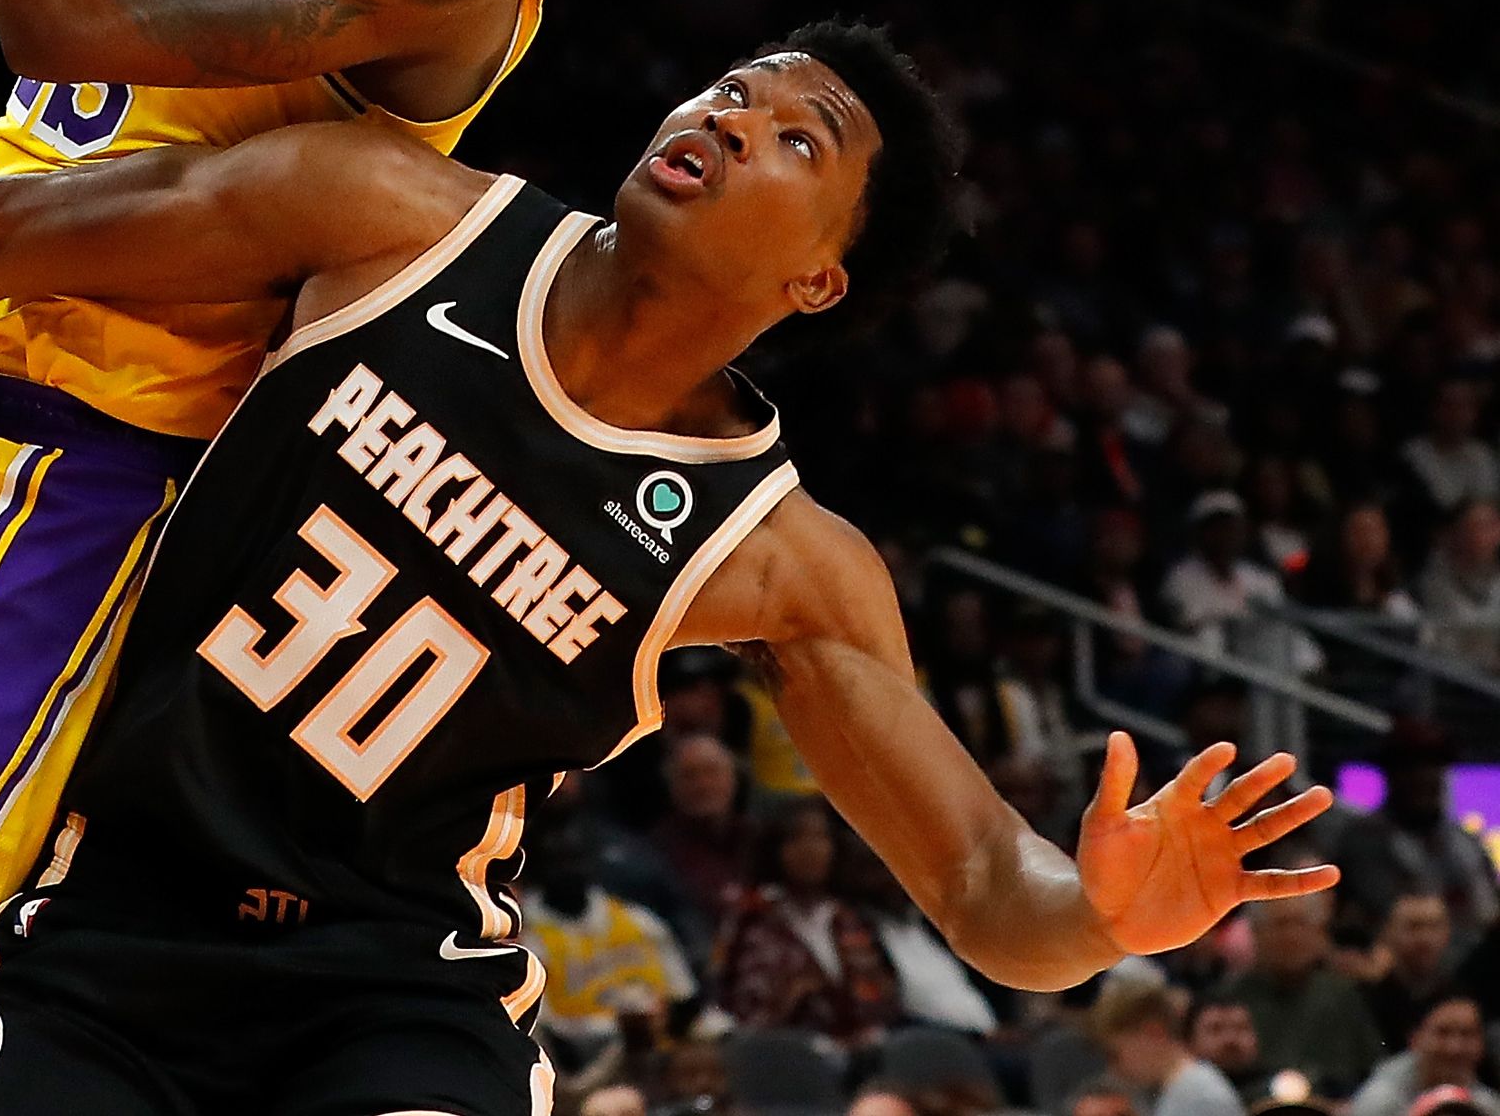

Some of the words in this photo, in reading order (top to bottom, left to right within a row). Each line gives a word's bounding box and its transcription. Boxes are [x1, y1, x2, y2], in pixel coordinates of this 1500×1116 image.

[196, 503, 491, 803] 30
[307, 362, 628, 664] PEACHTREE
[603, 500, 670, 564] sharecare
